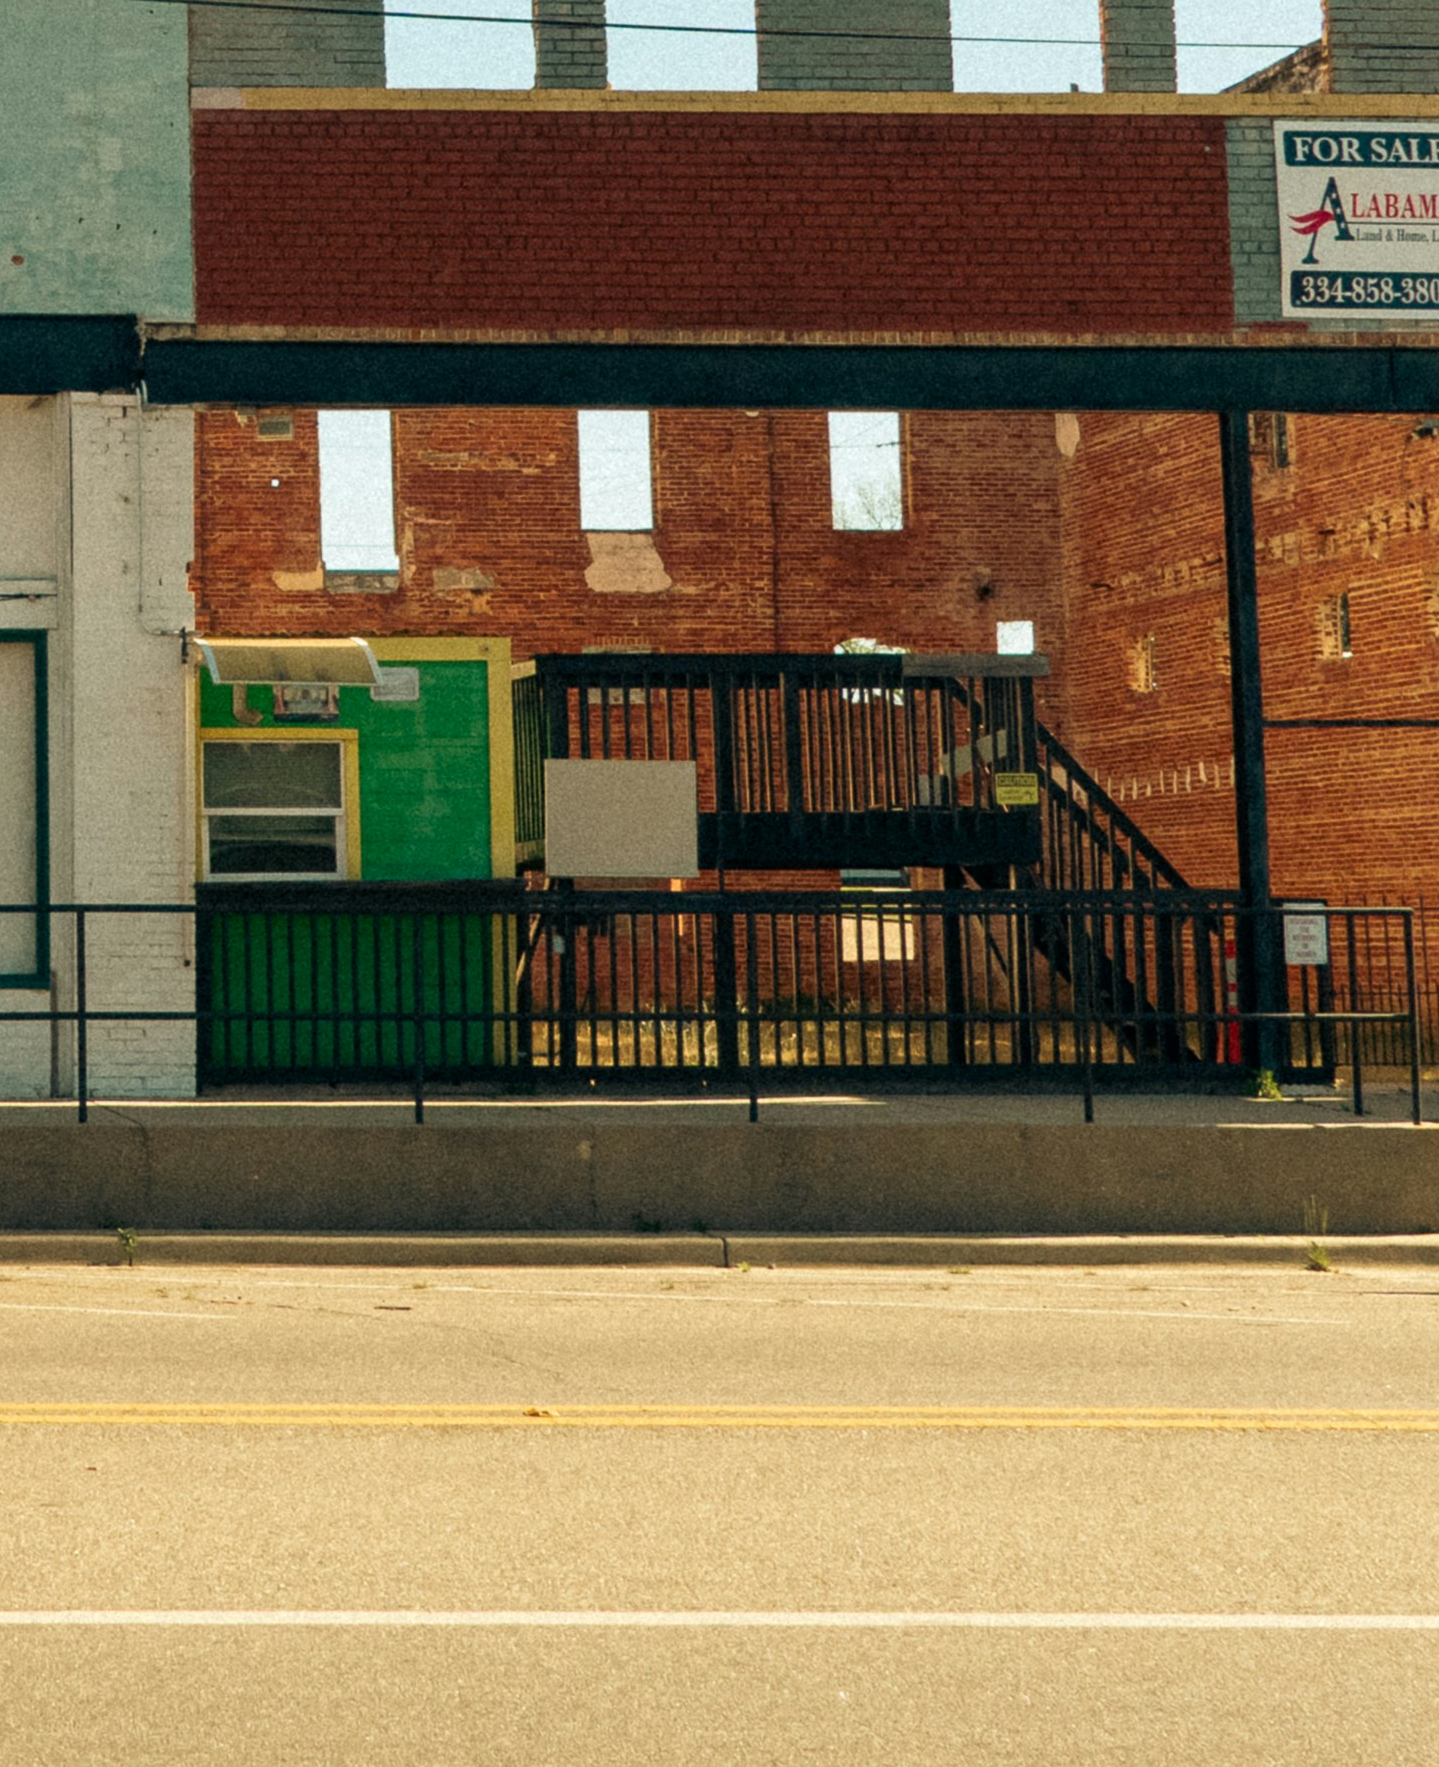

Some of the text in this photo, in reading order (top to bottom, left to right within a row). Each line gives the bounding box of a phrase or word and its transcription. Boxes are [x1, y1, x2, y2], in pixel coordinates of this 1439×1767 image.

[1292, 136, 1364, 162] FOR
[1356, 228, 1382, 242] Land
[1385, 228, 1393, 242] &
